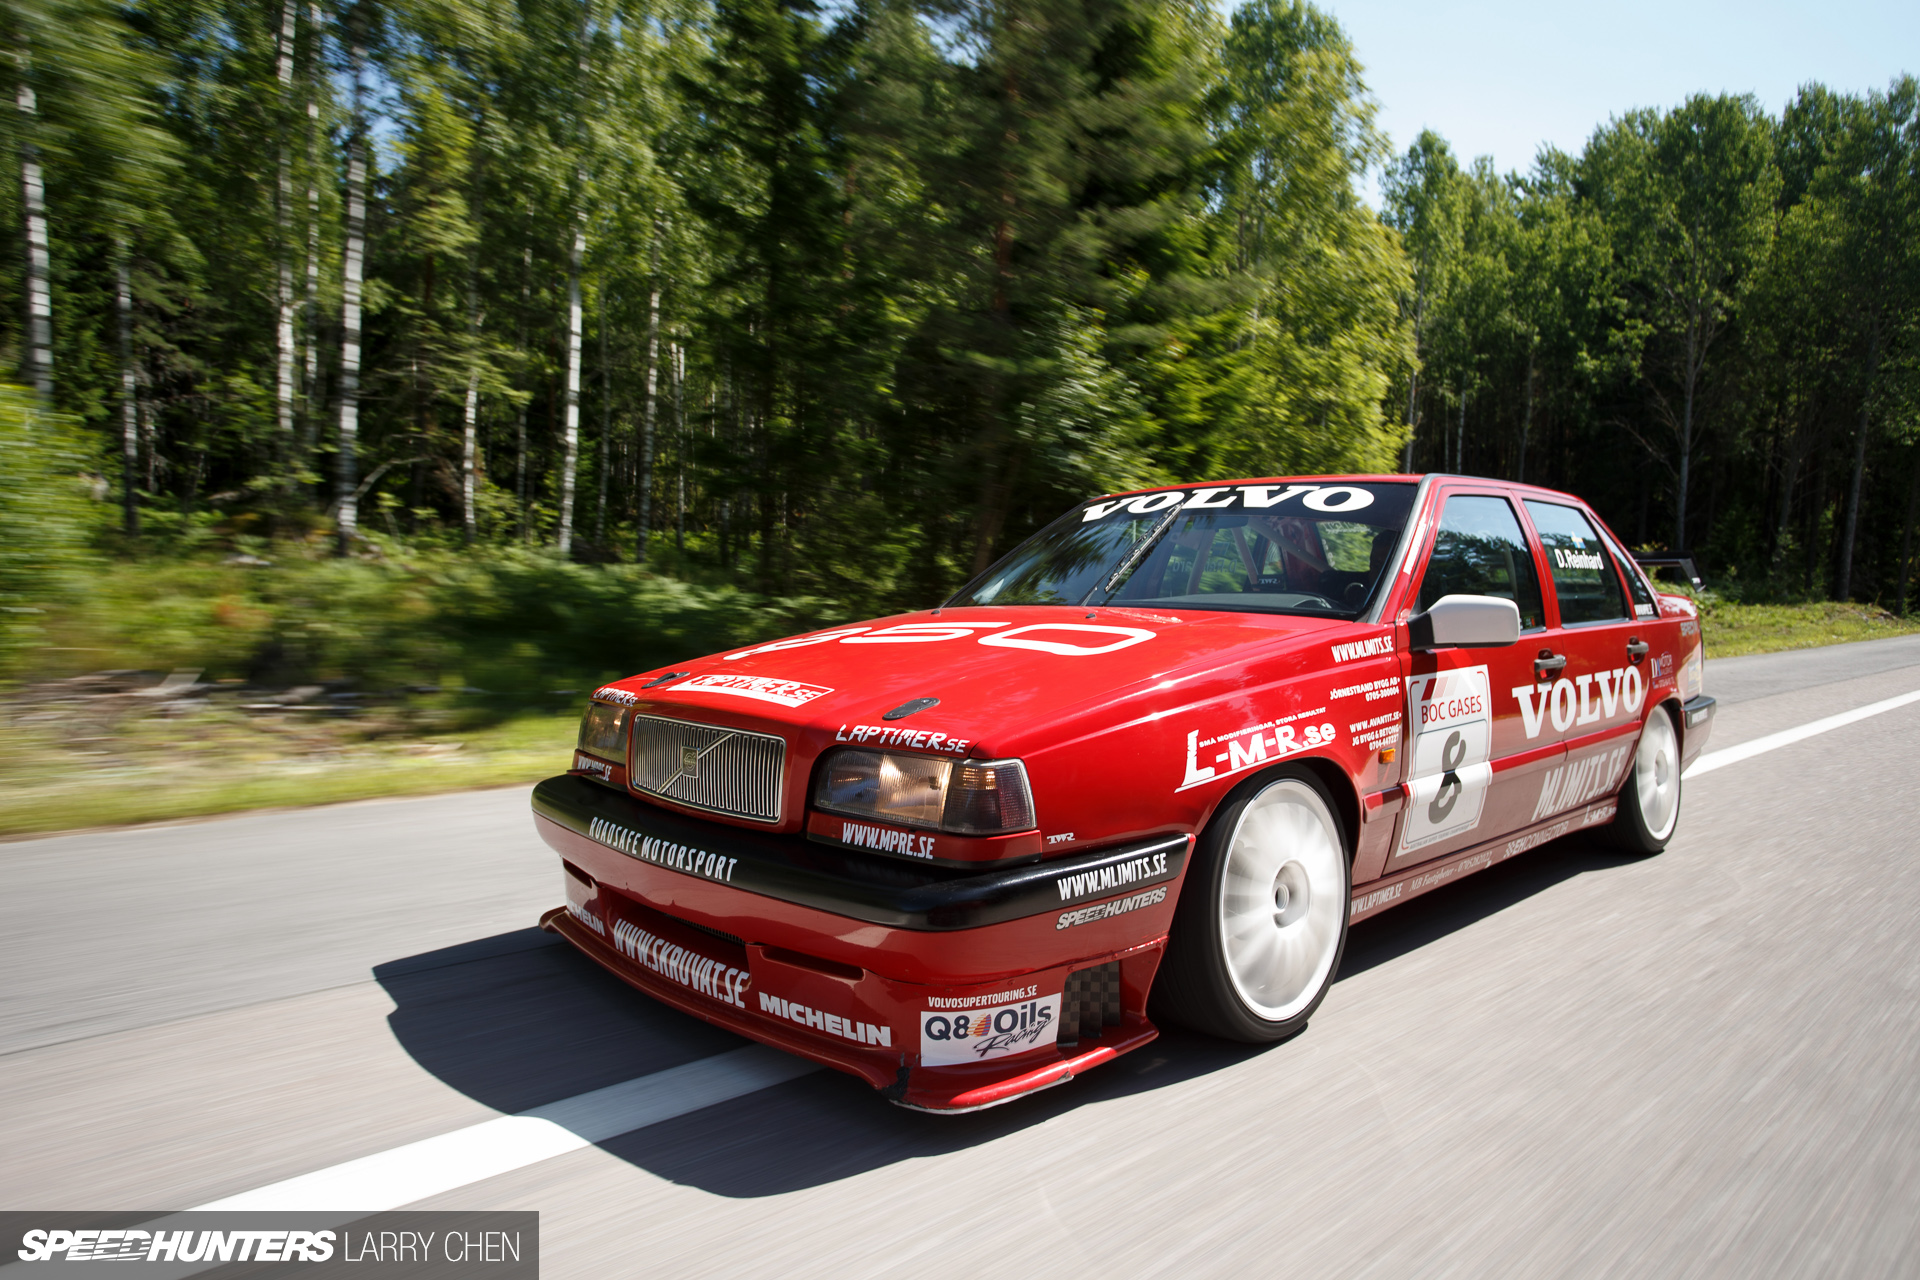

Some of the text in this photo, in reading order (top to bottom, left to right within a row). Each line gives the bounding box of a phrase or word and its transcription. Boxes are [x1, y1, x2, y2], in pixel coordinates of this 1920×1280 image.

[1082, 485, 1375, 522] VOLVO
[1554, 548, 1604, 570] D.Reinhard
[1331, 635, 1394, 663] WWW.MLIMITS.SE
[1374, 678, 1390, 690] BYGG
[1512, 665, 1642, 740] VOLVO
[1275, 714, 1297, 726] STORA
[1421, 695, 1482, 725] BOC GASES
[835, 724, 970, 754] LAPTIMER.SE
[1179, 722, 1337, 788] L-M-R.se
[1360, 731, 1375, 744] BYGG
[1428, 730, 1467, 824] 8
[1531, 746, 1627, 822] MLIMITS.SE
[589, 816, 738, 882] ROADSAFE MOTORSPORT
[842, 822, 935, 861] WWW.MPRE.SE
[1057, 852, 1168, 901] WWW.MLIMITS.SE
[1056, 887, 1167, 930] SPEEDHUNTERS
[613, 917, 750, 1009] WWW.SKRUVAT.SE
[928, 985, 1037, 1008] VOLVOSUPERTOURING.SE
[758, 991, 892, 1047] MICHELIN
[925, 1001, 1052, 1041] Q8 Oils
[973, 1016, 1056, 1057] Racing
